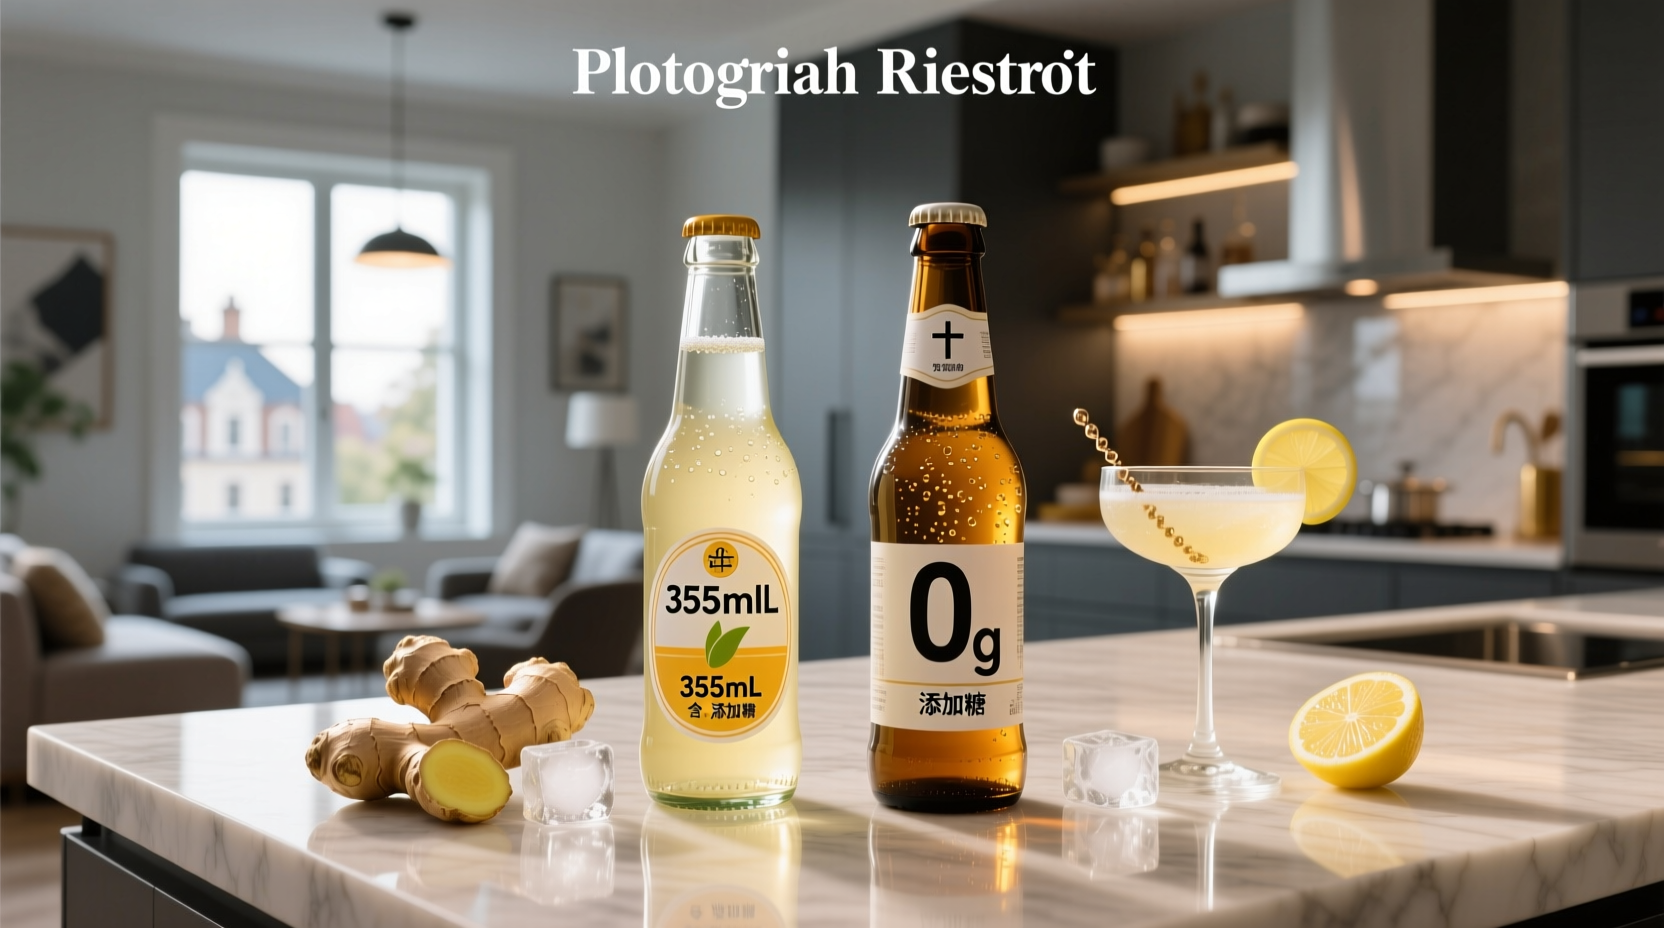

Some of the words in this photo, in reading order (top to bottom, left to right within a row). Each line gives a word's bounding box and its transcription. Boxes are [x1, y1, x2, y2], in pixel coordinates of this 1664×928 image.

[909, 561, 1001, 677] 0g
[679, 674, 763, 699] 355mL
[918, 690, 987, 717] 添加糖
